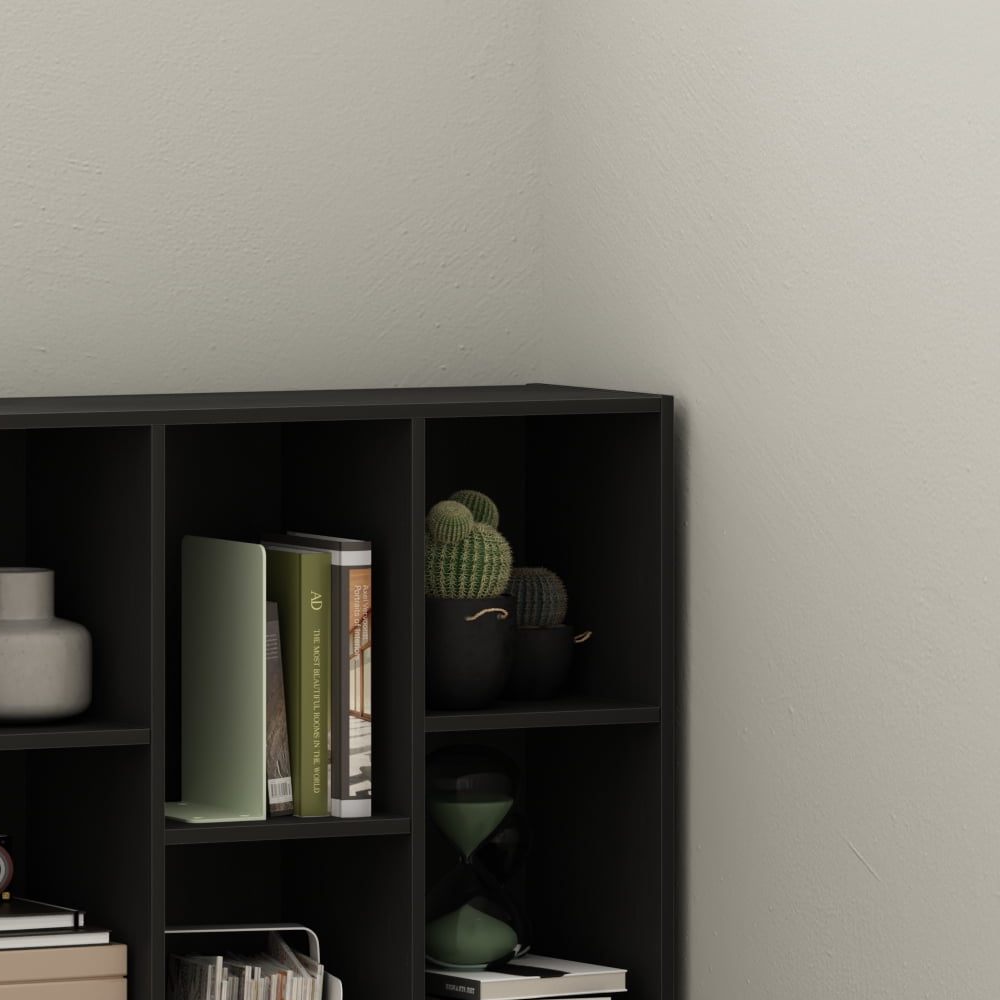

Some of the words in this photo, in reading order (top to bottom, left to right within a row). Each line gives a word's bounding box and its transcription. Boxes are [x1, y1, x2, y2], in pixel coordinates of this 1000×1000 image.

[310, 590, 323, 611] AD
[354, 585, 362, 617] Portraits
[355, 618, 362, 627] of
[313, 740, 320, 748] IN
